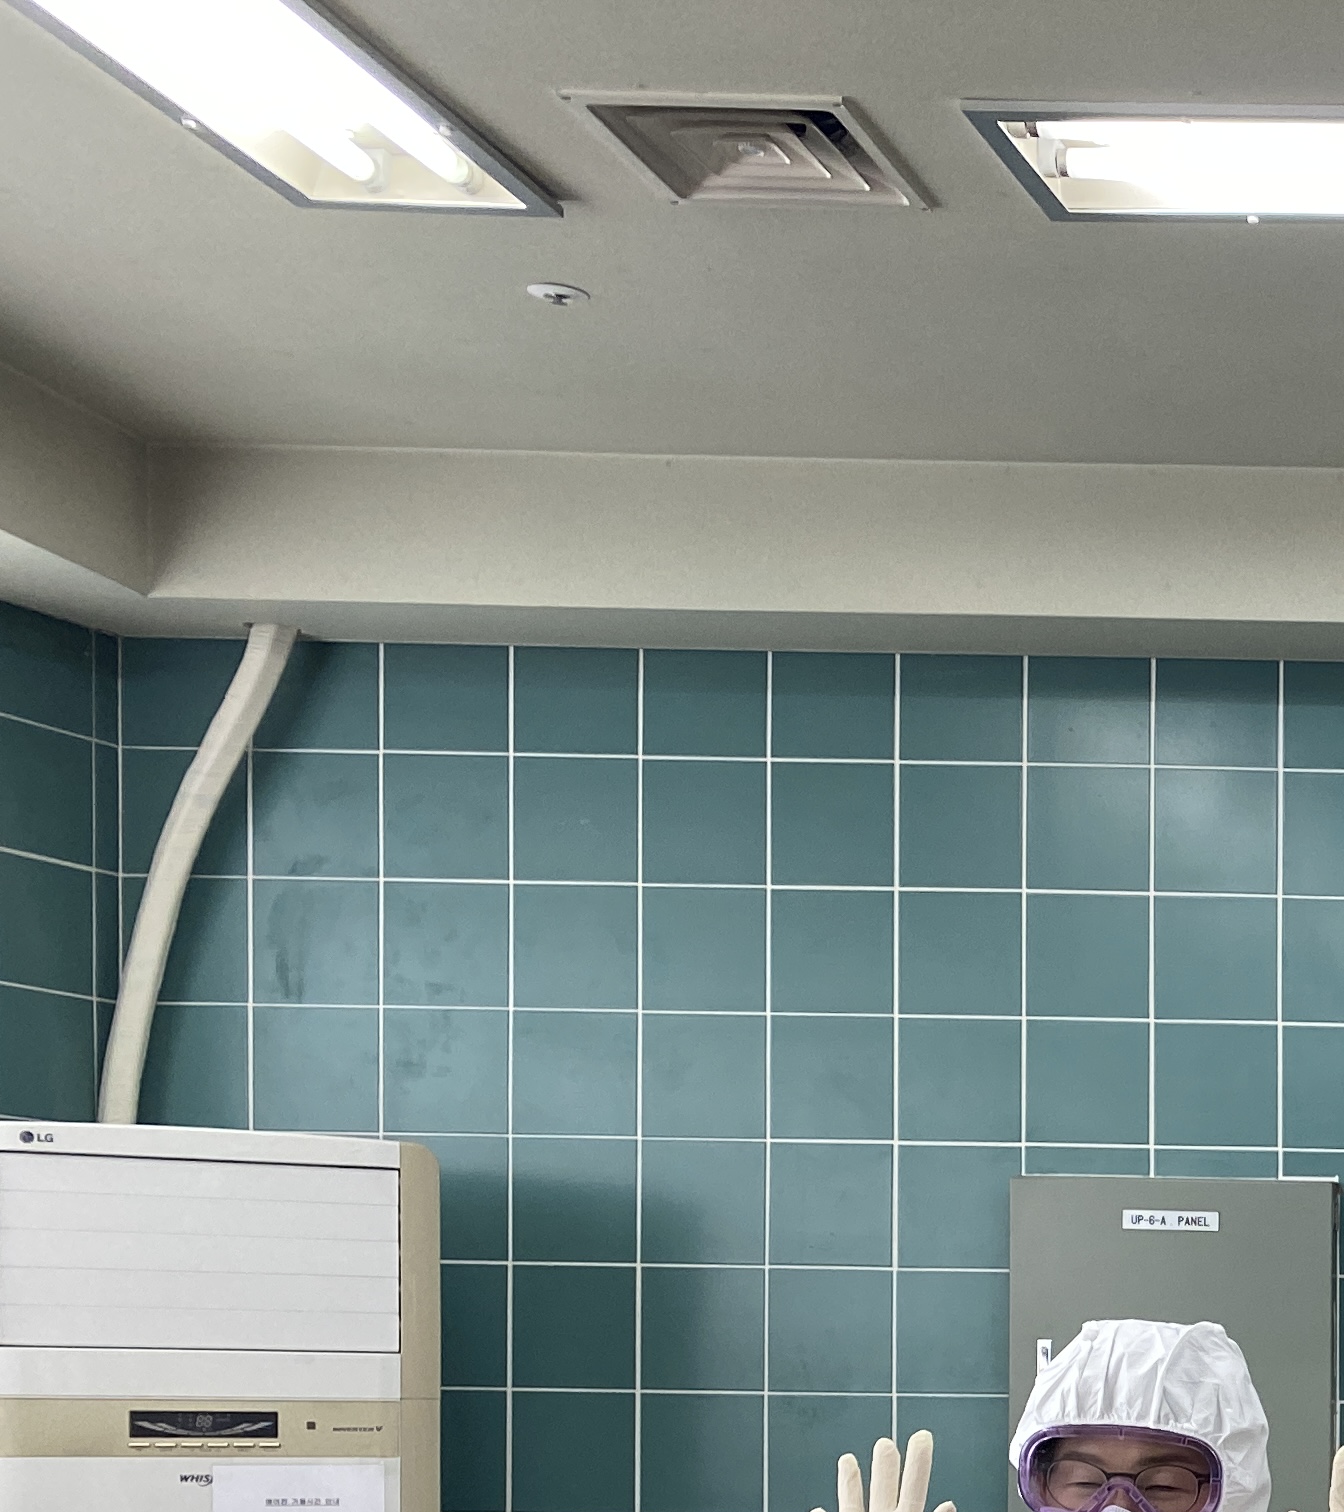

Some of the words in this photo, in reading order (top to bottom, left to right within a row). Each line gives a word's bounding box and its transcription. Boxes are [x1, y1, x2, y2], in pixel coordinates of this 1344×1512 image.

[37, 1133, 54, 1143] LG
[1131, 1215, 1167, 1226] UP-6-A
[1177, 1216, 1210, 1227] PANEL
[179, 1473, 213, 1484] WHIS
